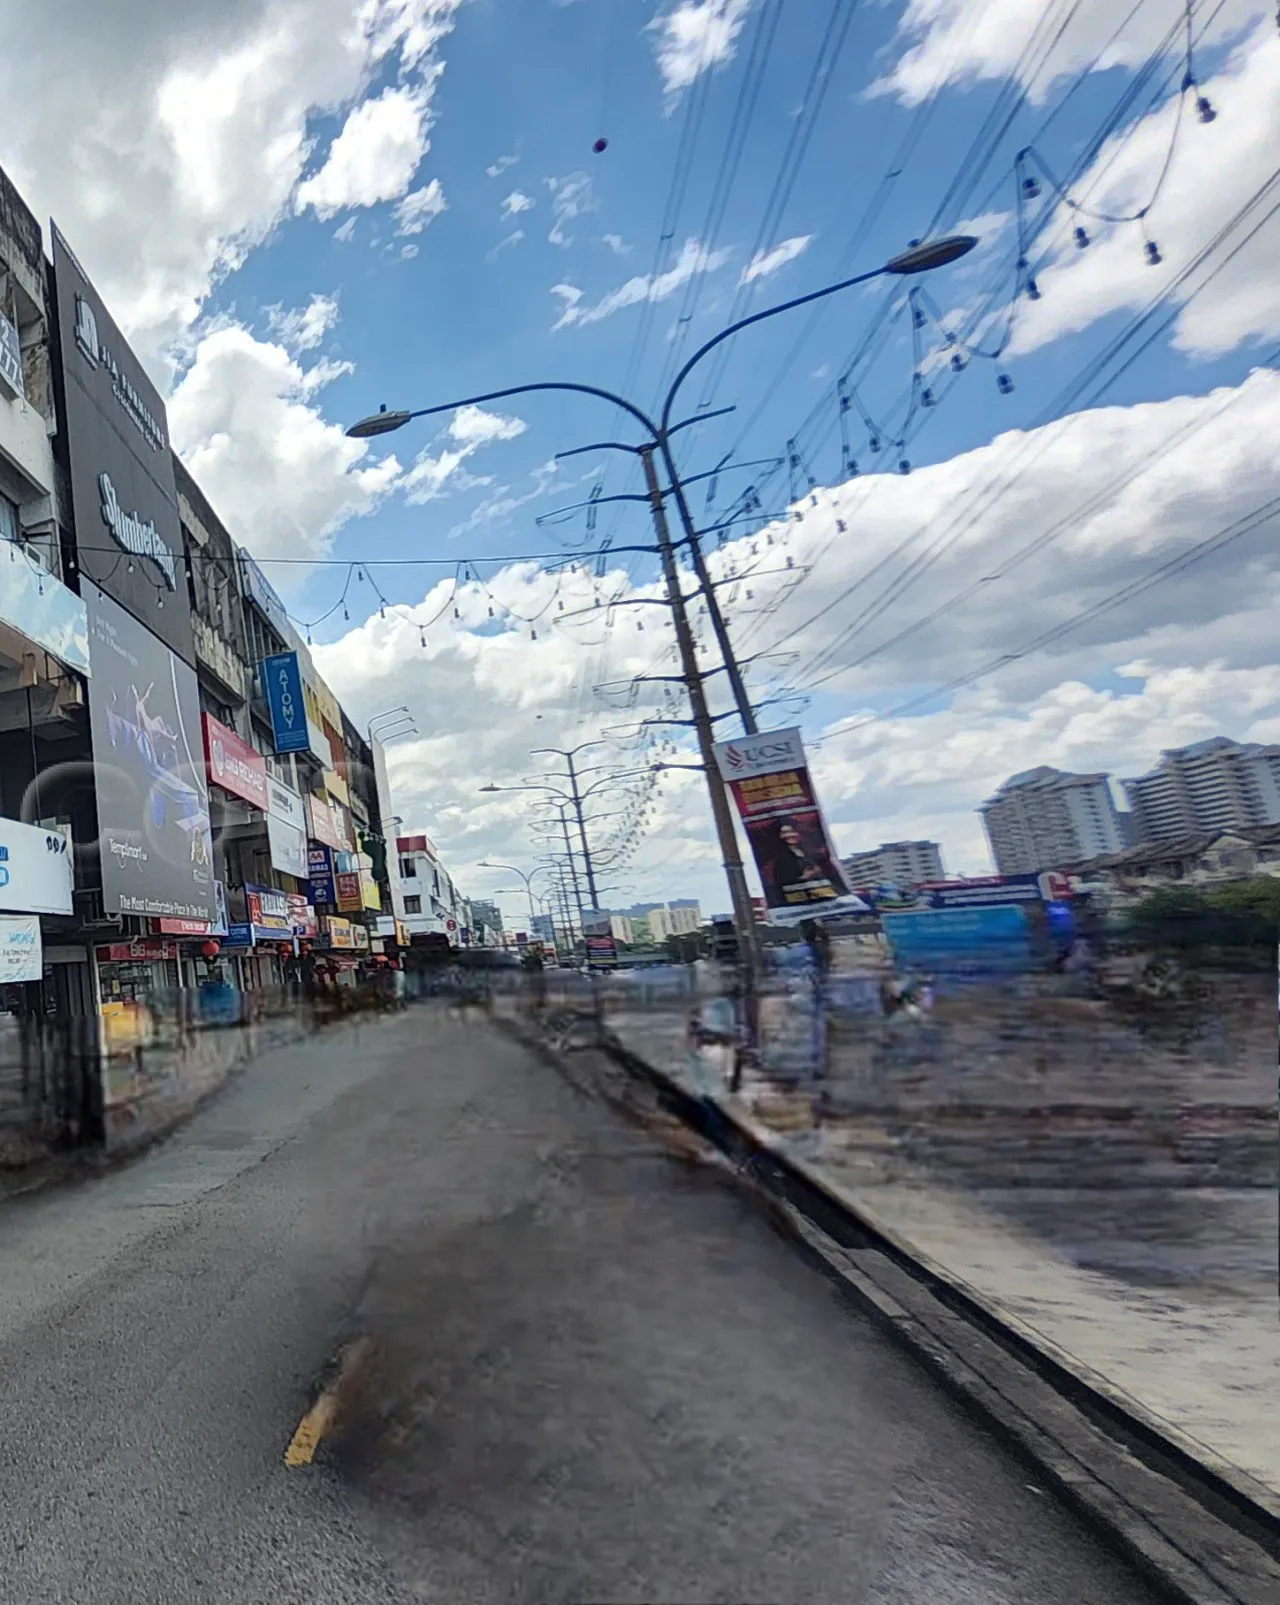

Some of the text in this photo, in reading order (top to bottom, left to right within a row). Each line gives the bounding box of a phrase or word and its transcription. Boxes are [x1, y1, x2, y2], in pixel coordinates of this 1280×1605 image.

[99, 472, 177, 592] Slumberland
[278, 668, 295, 730] ATOMY
[744, 741, 793, 762] UCSI
